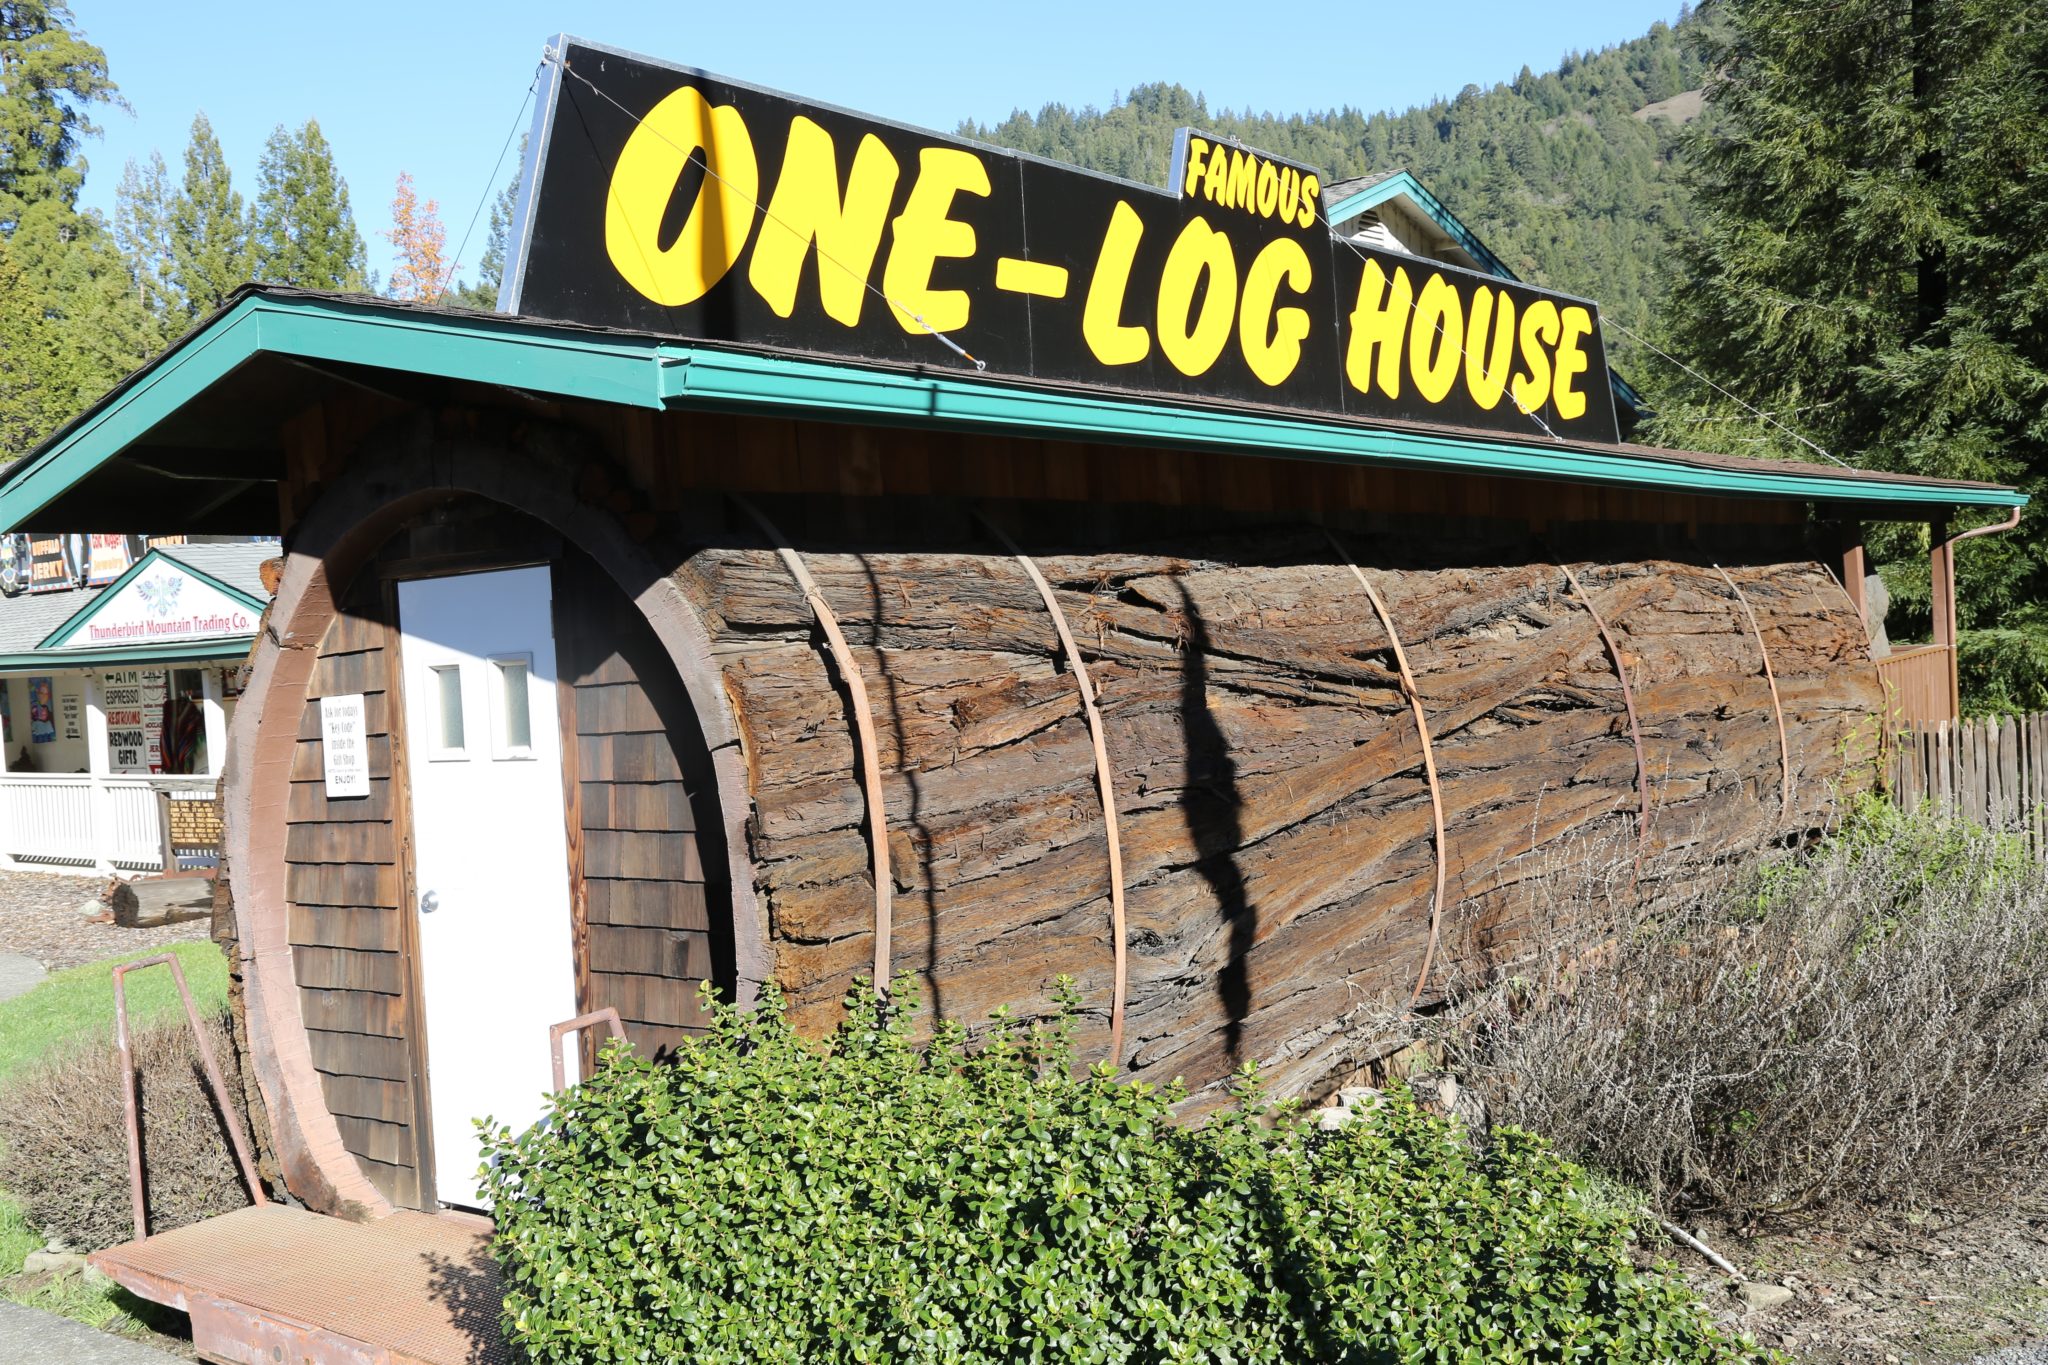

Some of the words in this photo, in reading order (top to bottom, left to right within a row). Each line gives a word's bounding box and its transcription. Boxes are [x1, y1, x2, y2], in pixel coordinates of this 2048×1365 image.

[1185, 137, 1319, 228] FAMOUS
[1346, 257, 1593, 421] HOUSE
[32, 559, 63, 580] JERKY
[89, 621, 144, 639] Thunderbird
[146, 617, 191, 635] Mountain
[193, 614, 230, 633] Trading
[232, 612, 250, 629] Co.
[105, 689, 139, 705] ESPRESSO
[108, 711, 141, 725] RESTROOMS
[109, 730, 143, 747] REDWOOD
[331, 738, 346, 750] inside
[346, 737, 355, 749] the
[118, 749, 138, 765] GIFTS
[333, 754, 342, 766] Gift
[342, 753, 355, 766] Shop
[334, 775, 356, 785] ENJOY!
